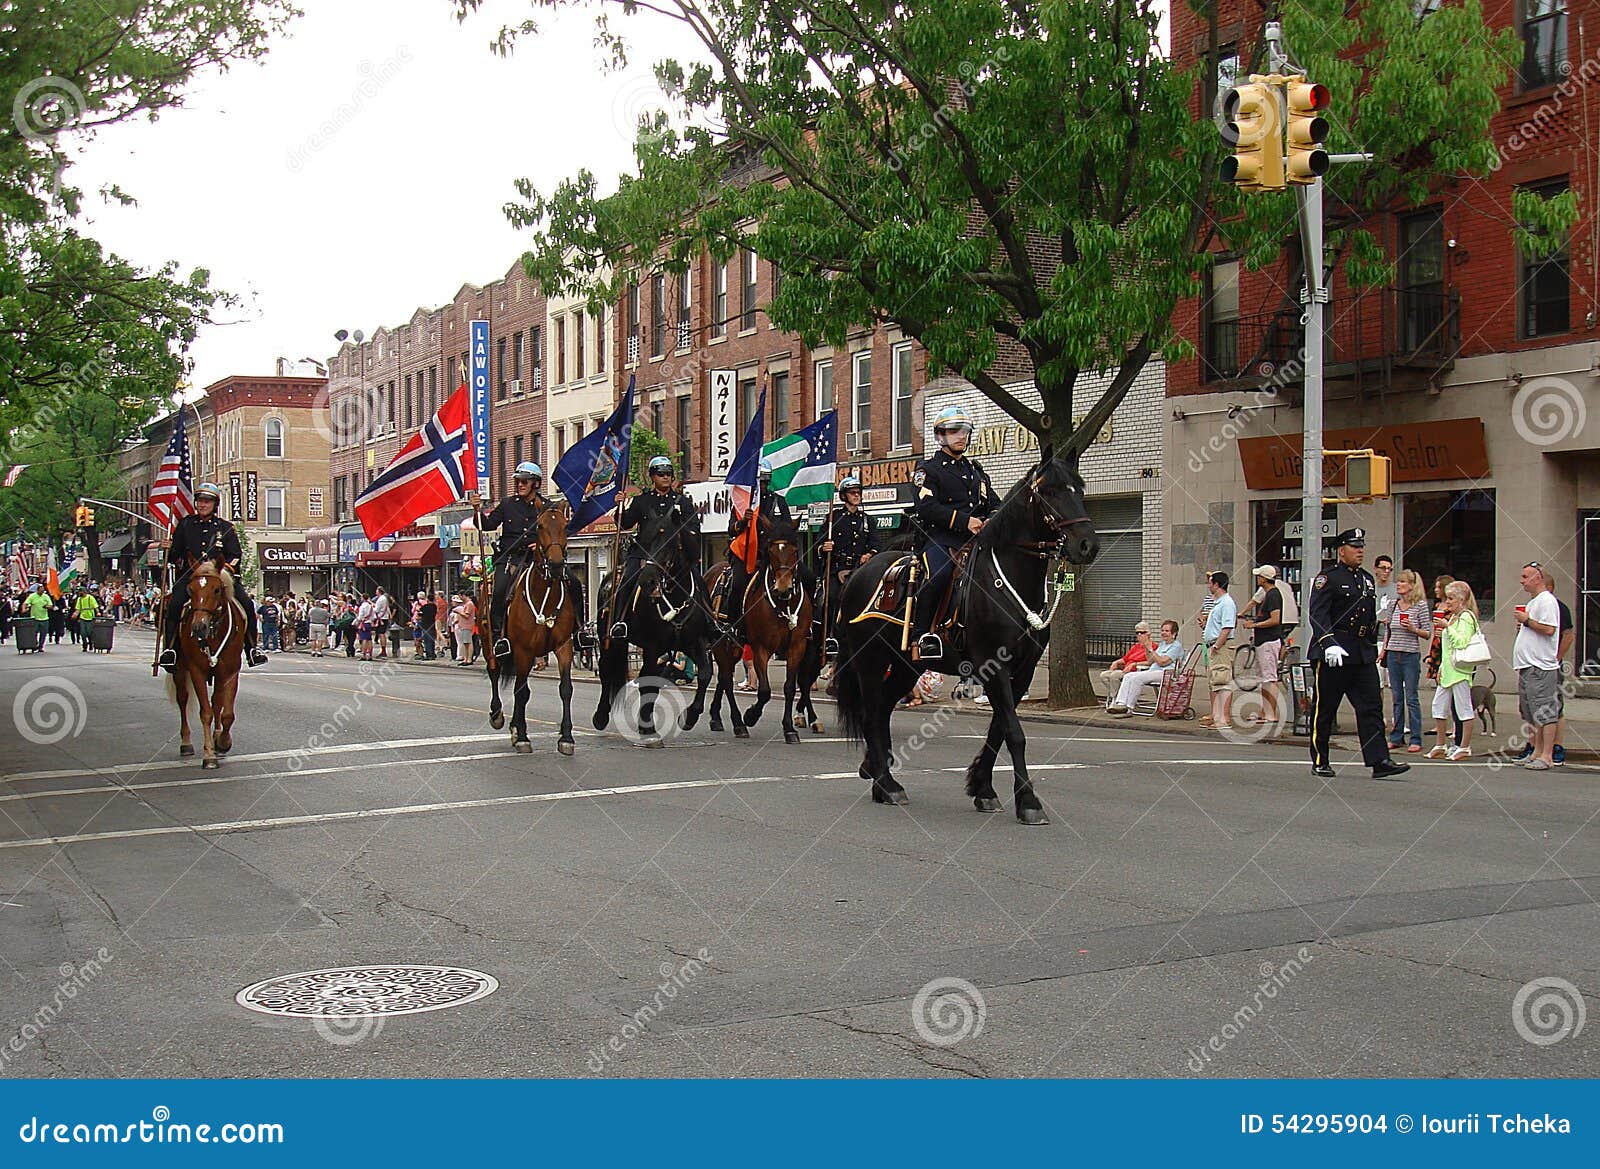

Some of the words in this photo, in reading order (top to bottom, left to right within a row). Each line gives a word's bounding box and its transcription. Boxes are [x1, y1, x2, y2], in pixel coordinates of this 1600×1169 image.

[476, 327, 486, 369] LAW
[716, 374, 731, 426] NAIL
[476, 376, 486, 472] OFFICES
[716, 432, 730, 471] SPA
[1392, 433, 1449, 471] Salon
[862, 460, 917, 488] BAKERY
[231, 479, 241, 518] PIZZA
